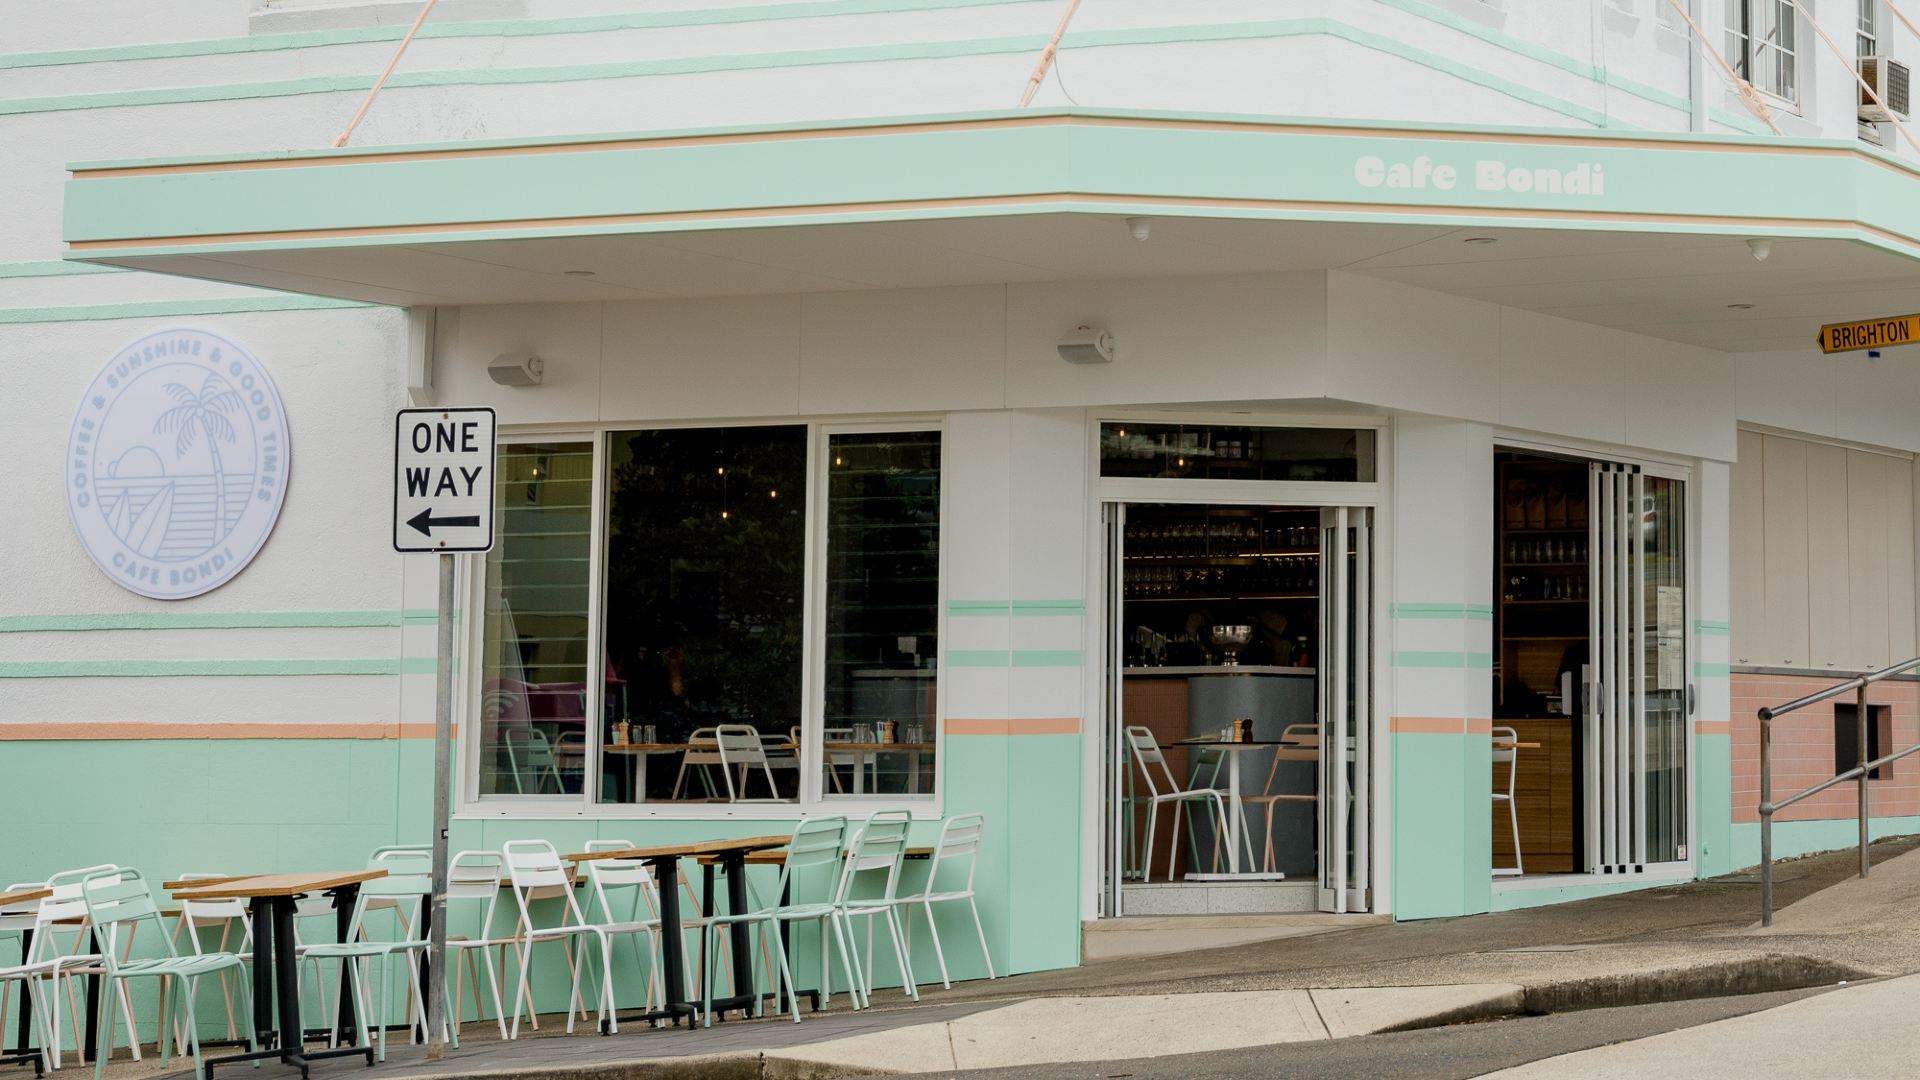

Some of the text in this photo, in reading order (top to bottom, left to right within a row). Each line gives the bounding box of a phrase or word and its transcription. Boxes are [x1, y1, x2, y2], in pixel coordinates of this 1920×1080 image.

[1354, 155, 1604, 196] Cafe Bondi
[1831, 319, 1910, 349] BRIGHTON
[74, 340, 278, 509] COFFEE & SUNSHINE & GOOD TIMES
[412, 422, 479, 453] ONE
[405, 466, 483, 498] WAY
[112, 547, 235, 587] CAFE BONDI
